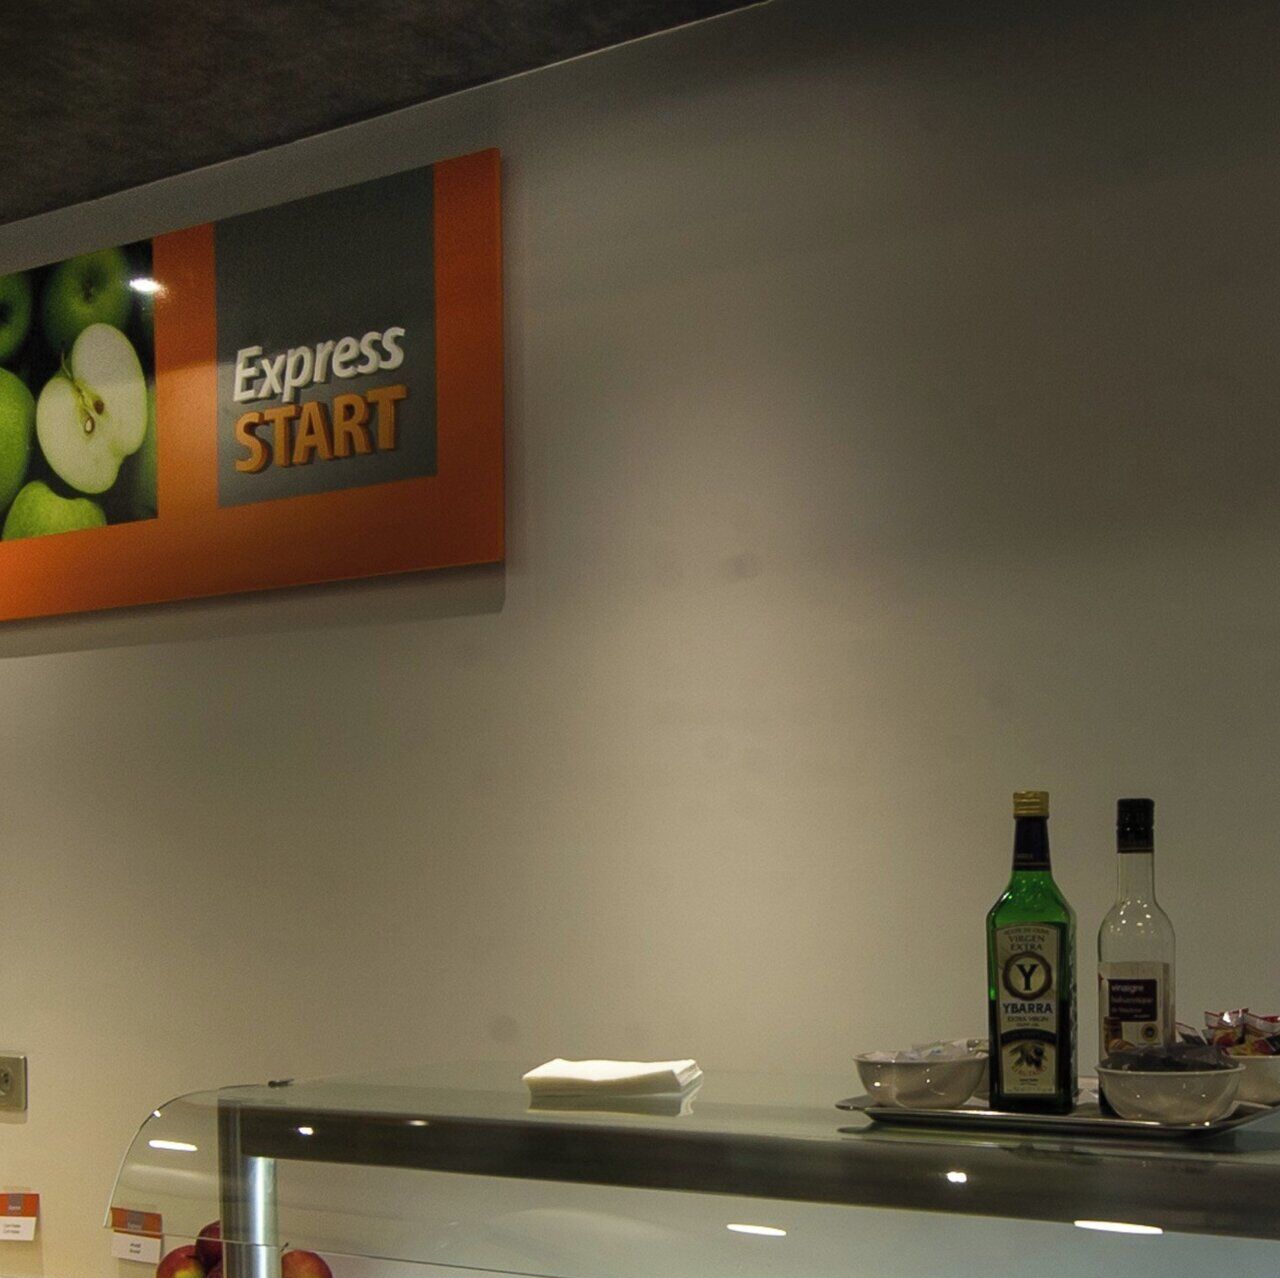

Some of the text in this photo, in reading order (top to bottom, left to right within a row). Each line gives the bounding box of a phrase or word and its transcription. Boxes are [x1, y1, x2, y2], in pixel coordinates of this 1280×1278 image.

[233, 326, 406, 403] Express
[234, 384, 408, 474] START
[1016, 963, 1039, 991] Y
[1002, 1003, 1053, 1014] YBARRA
